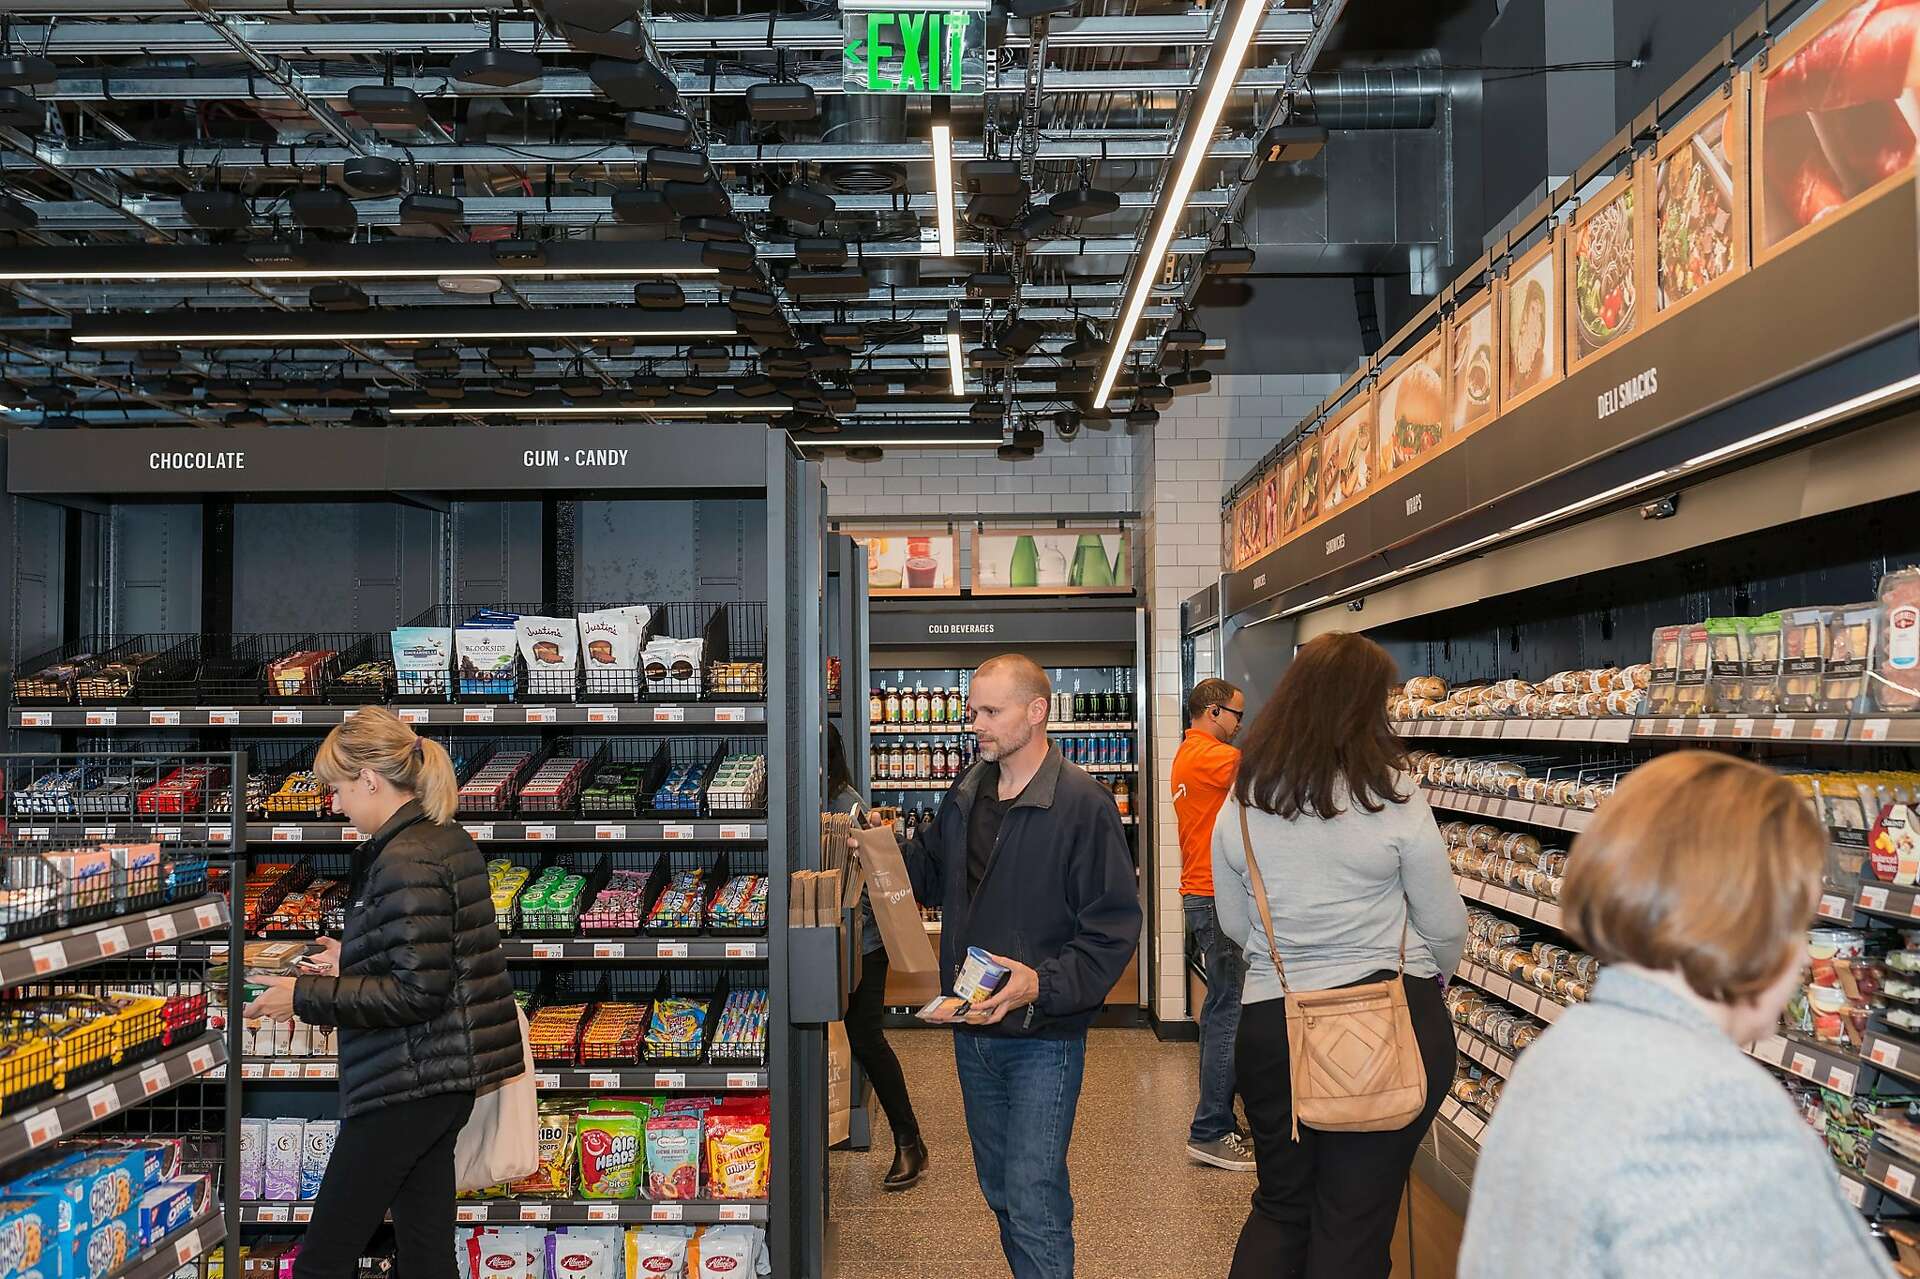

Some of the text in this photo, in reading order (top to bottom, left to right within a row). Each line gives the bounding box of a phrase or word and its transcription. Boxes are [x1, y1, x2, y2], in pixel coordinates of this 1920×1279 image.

[867, 13, 970, 91] EXIT
[1597, 367, 1658, 420] DELI SNACKS
[149, 452, 245, 470] CHOCOLATE
[522, 449, 629, 467] GUM CANDY
[526, 625, 564, 638] Justin's
[585, 621, 618, 636] Justin's
[928, 624, 995, 634] COLD BEVERAGES
[538, 1129, 562, 1140] IBO
[611, 1136, 636, 1154] AIR
[595, 1150, 637, 1171] HEADS
[726, 1160, 756, 1176] minis
